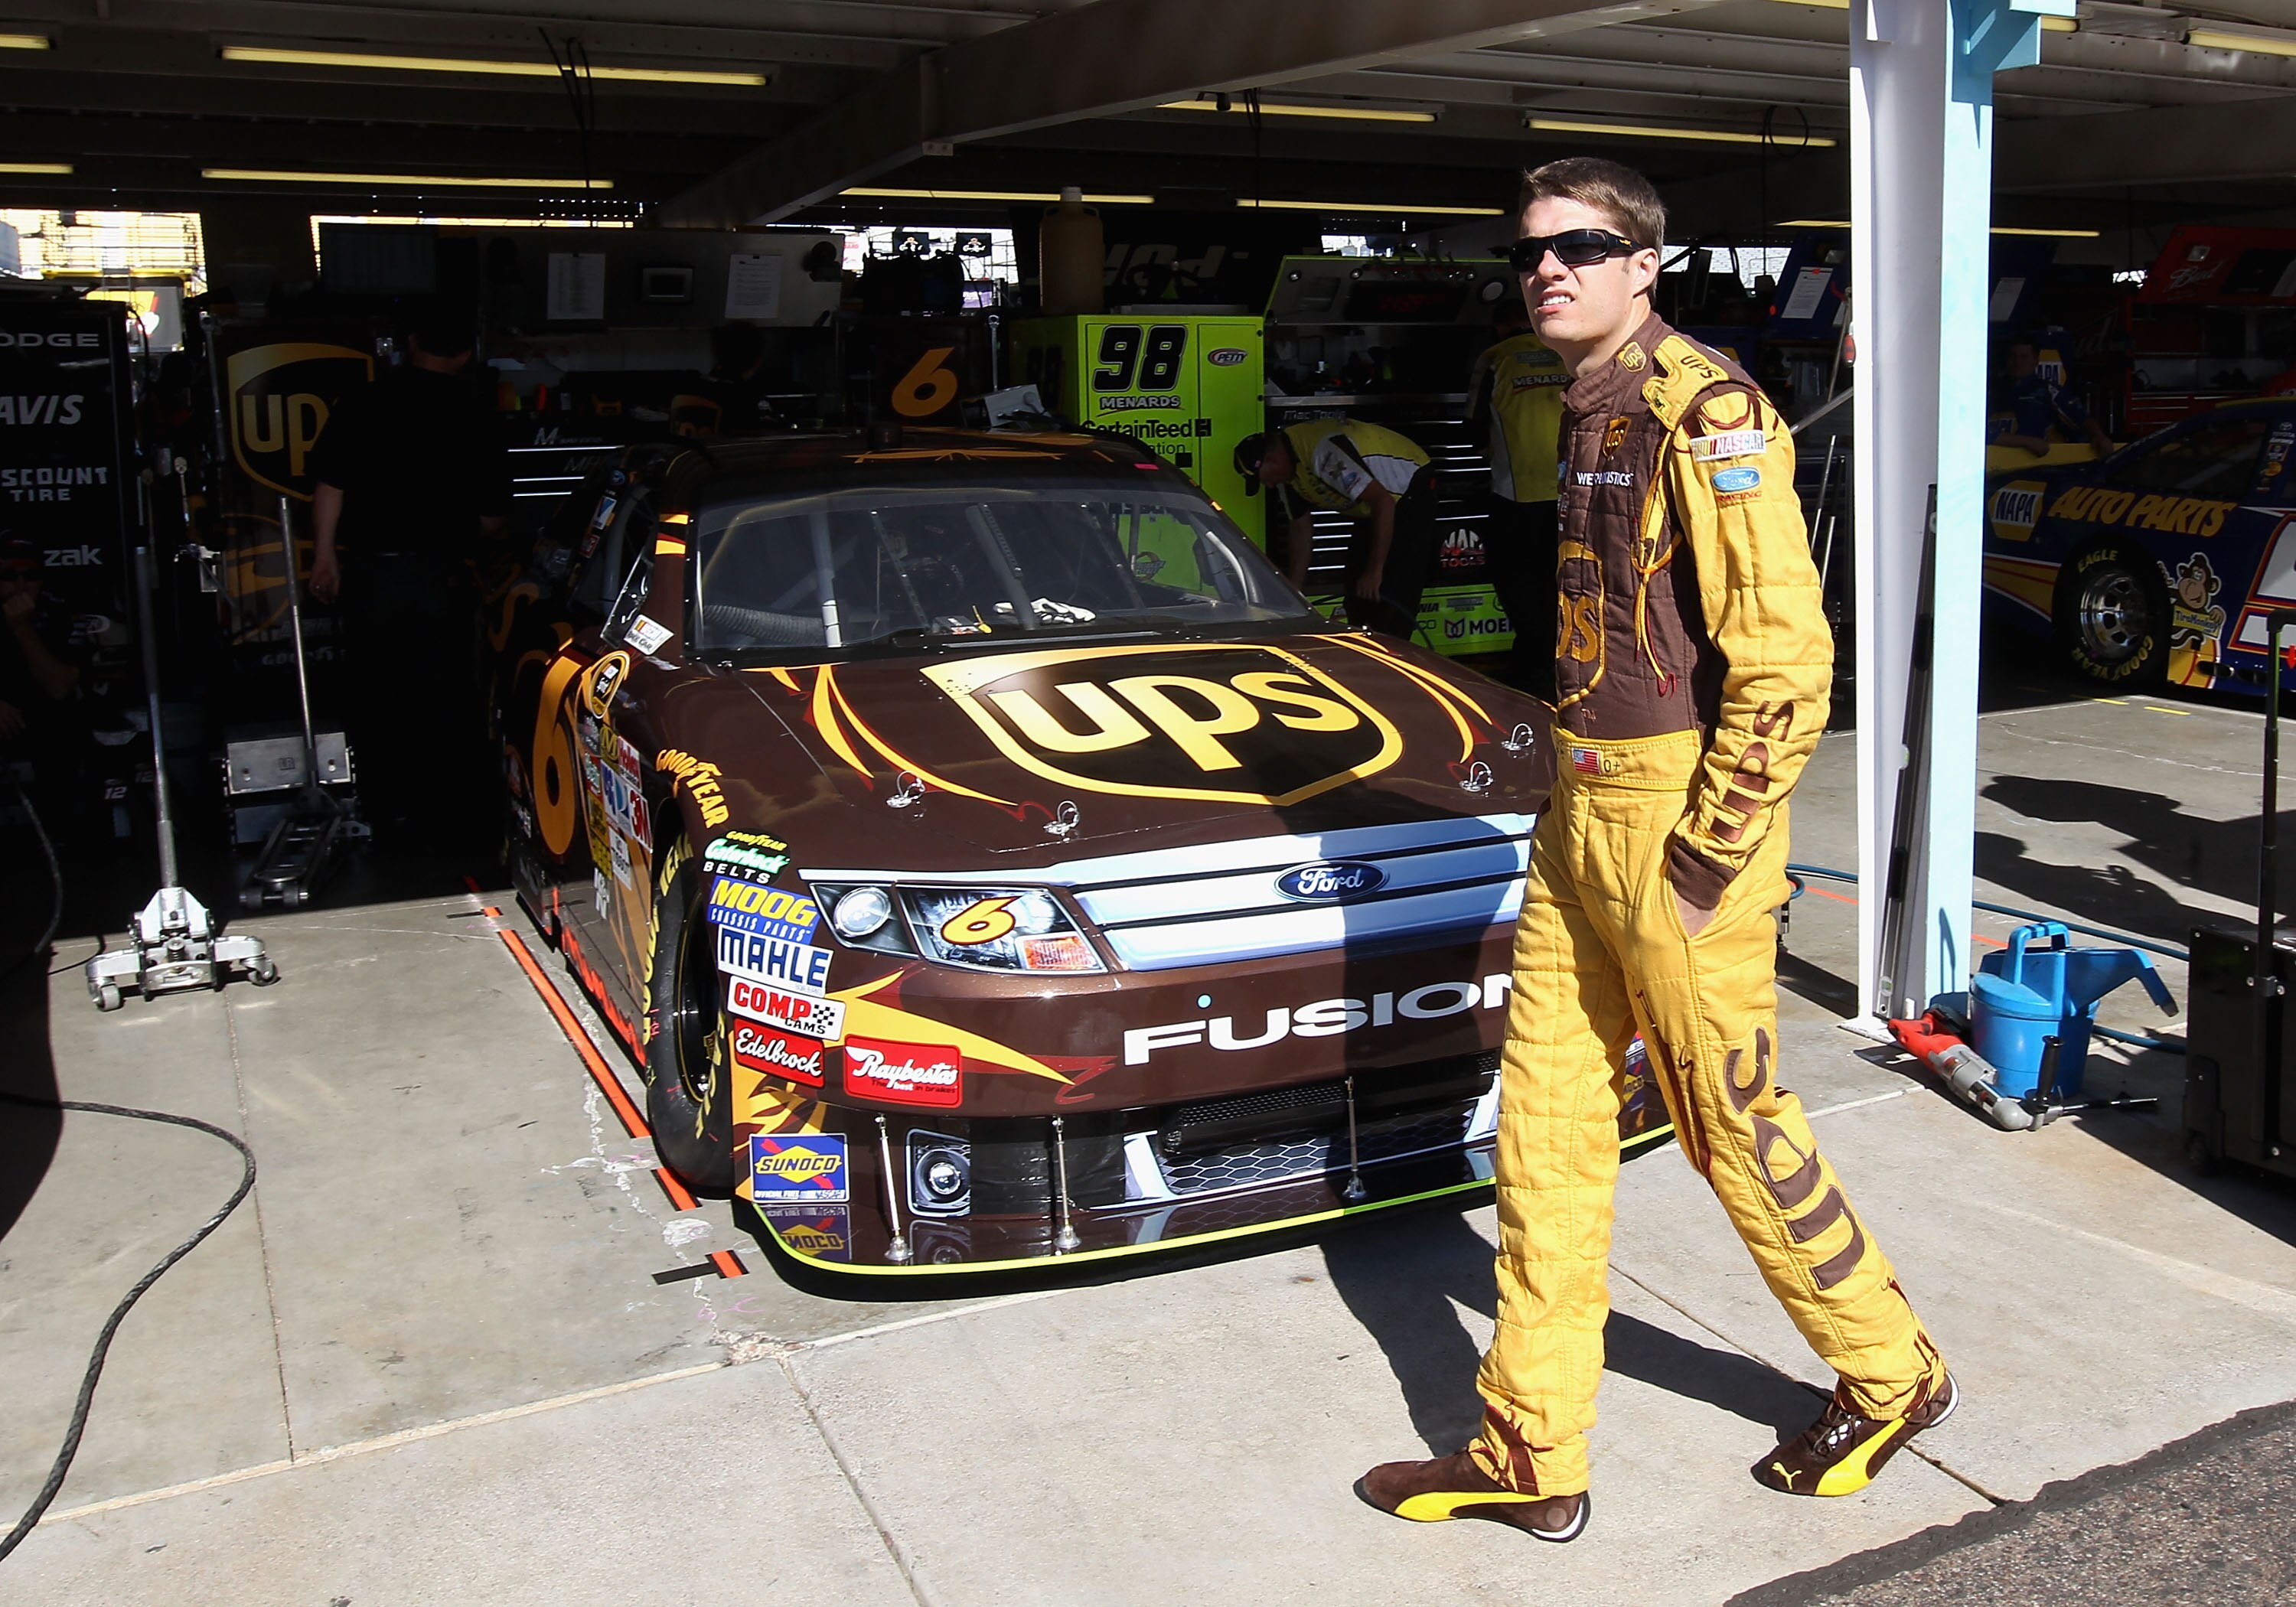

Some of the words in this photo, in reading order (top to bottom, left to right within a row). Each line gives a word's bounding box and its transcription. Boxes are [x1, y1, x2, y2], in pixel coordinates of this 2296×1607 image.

[0, 332, 100, 347] ODGE
[1092, 324, 1189, 392] 98
[1681, 355, 1719, 379] UPS
[891, 346, 958, 418] 6
[1101, 396, 1181, 409] MENARDS
[0, 466, 109, 488] SCOUNT
[1577, 471, 1593, 486] WE
[9, 487, 73, 502] TIRE
[1994, 491, 2037, 524] NAPA
[2047, 486, 2138, 526] AUTO
[2125, 494, 2239, 538] PARTS
[2077, 548, 2120, 574] EAGLE
[2070, 634, 2155, 681] GOODYEAR
[533, 654, 582, 856] 6
[103, 784, 129, 800] 12
[656, 748, 729, 829] GOODYEAR
[726, 830, 788, 851] GOODYEAR
[703, 860, 771, 885] BELTS
[1297, 866, 1365, 895] Ford
[709, 878, 819, 927] MOOG
[711, 908, 758, 931] CHASSIS
[762, 920, 811, 943] PARTS
[941, 895, 1024, 946] 6
[720, 927, 830, 988] MAHLE
[733, 982, 812, 1021] COMP
[784, 1017, 827, 1035] CAMS
[735, 1028, 823, 1077] Edelbrock
[845, 1045, 958, 1089] Raybestos
[893, 1082, 914, 1091] best
[760, 1158, 837, 1172] SUNOCO
